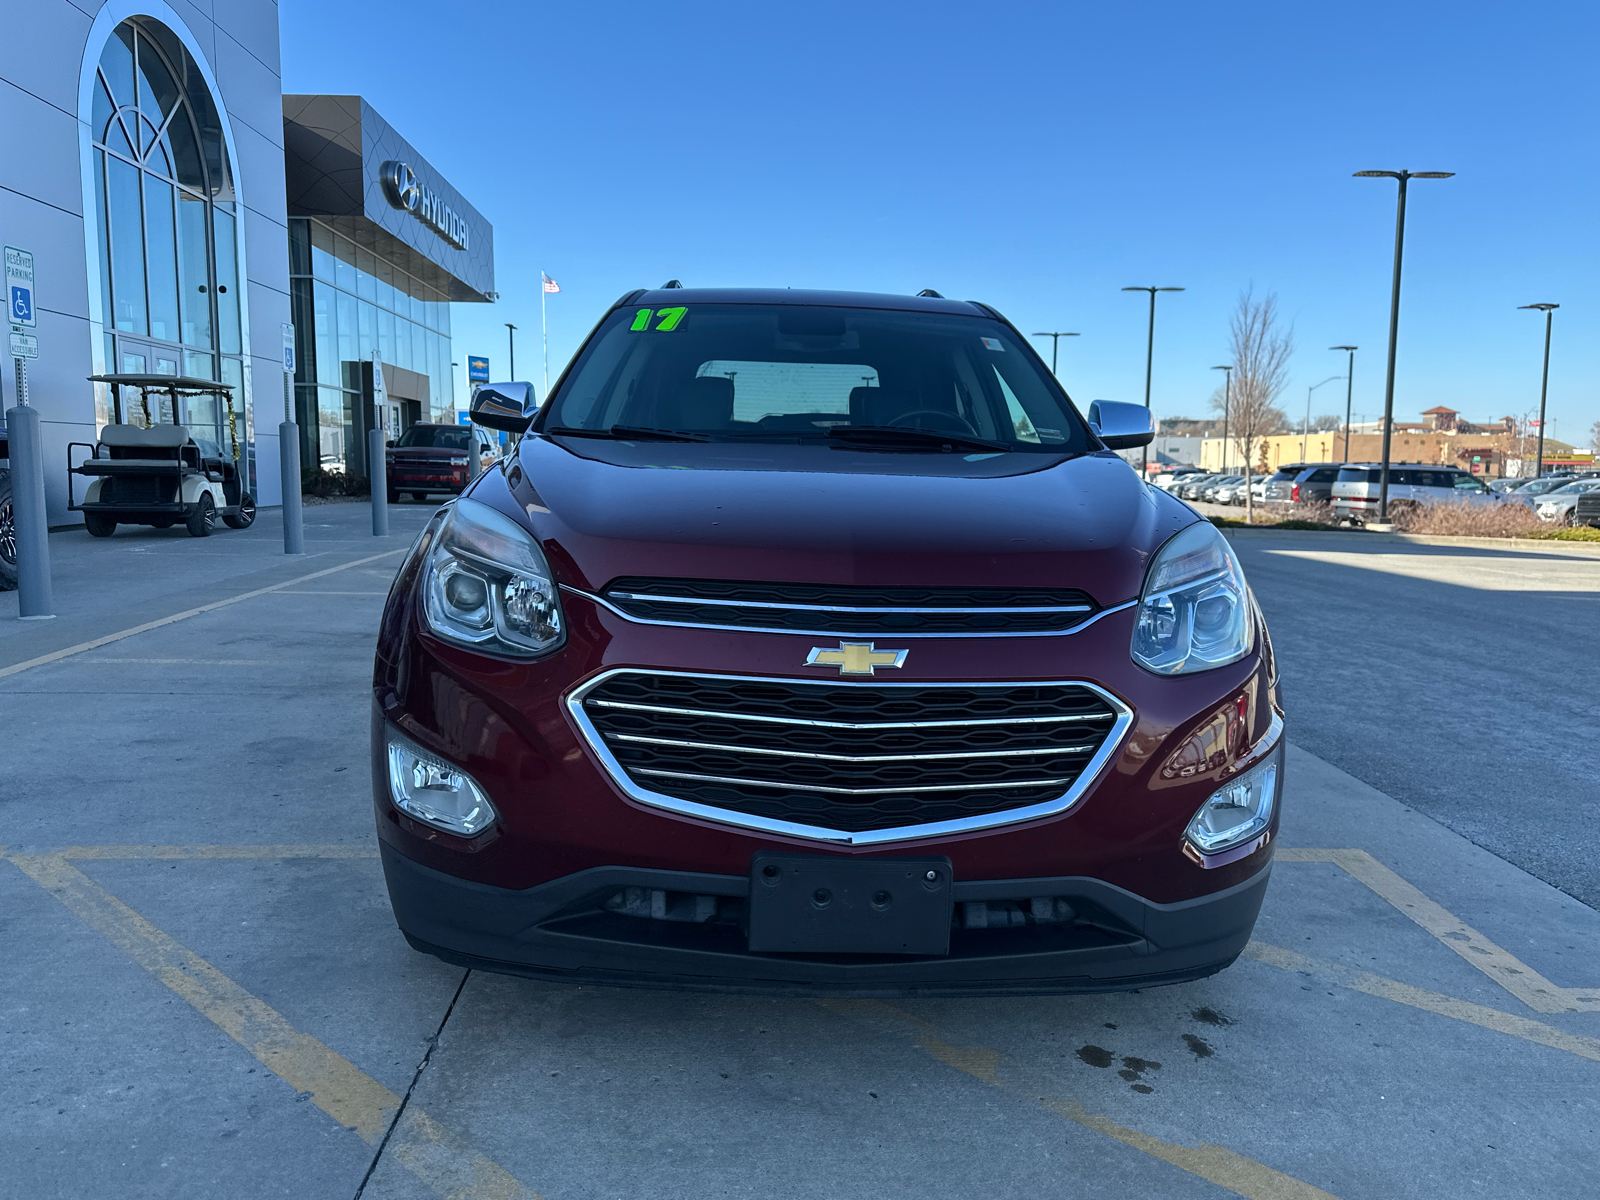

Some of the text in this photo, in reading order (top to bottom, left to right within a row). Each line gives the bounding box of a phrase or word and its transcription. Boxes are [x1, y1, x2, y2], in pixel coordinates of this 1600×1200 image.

[421, 183, 469, 251] HYUNDAI
[6, 252, 32, 269] RESERVED
[6, 266, 33, 282] PARKING
[630, 306, 689, 332] 17
[11, 345, 37, 356] ACCESSIBLE
